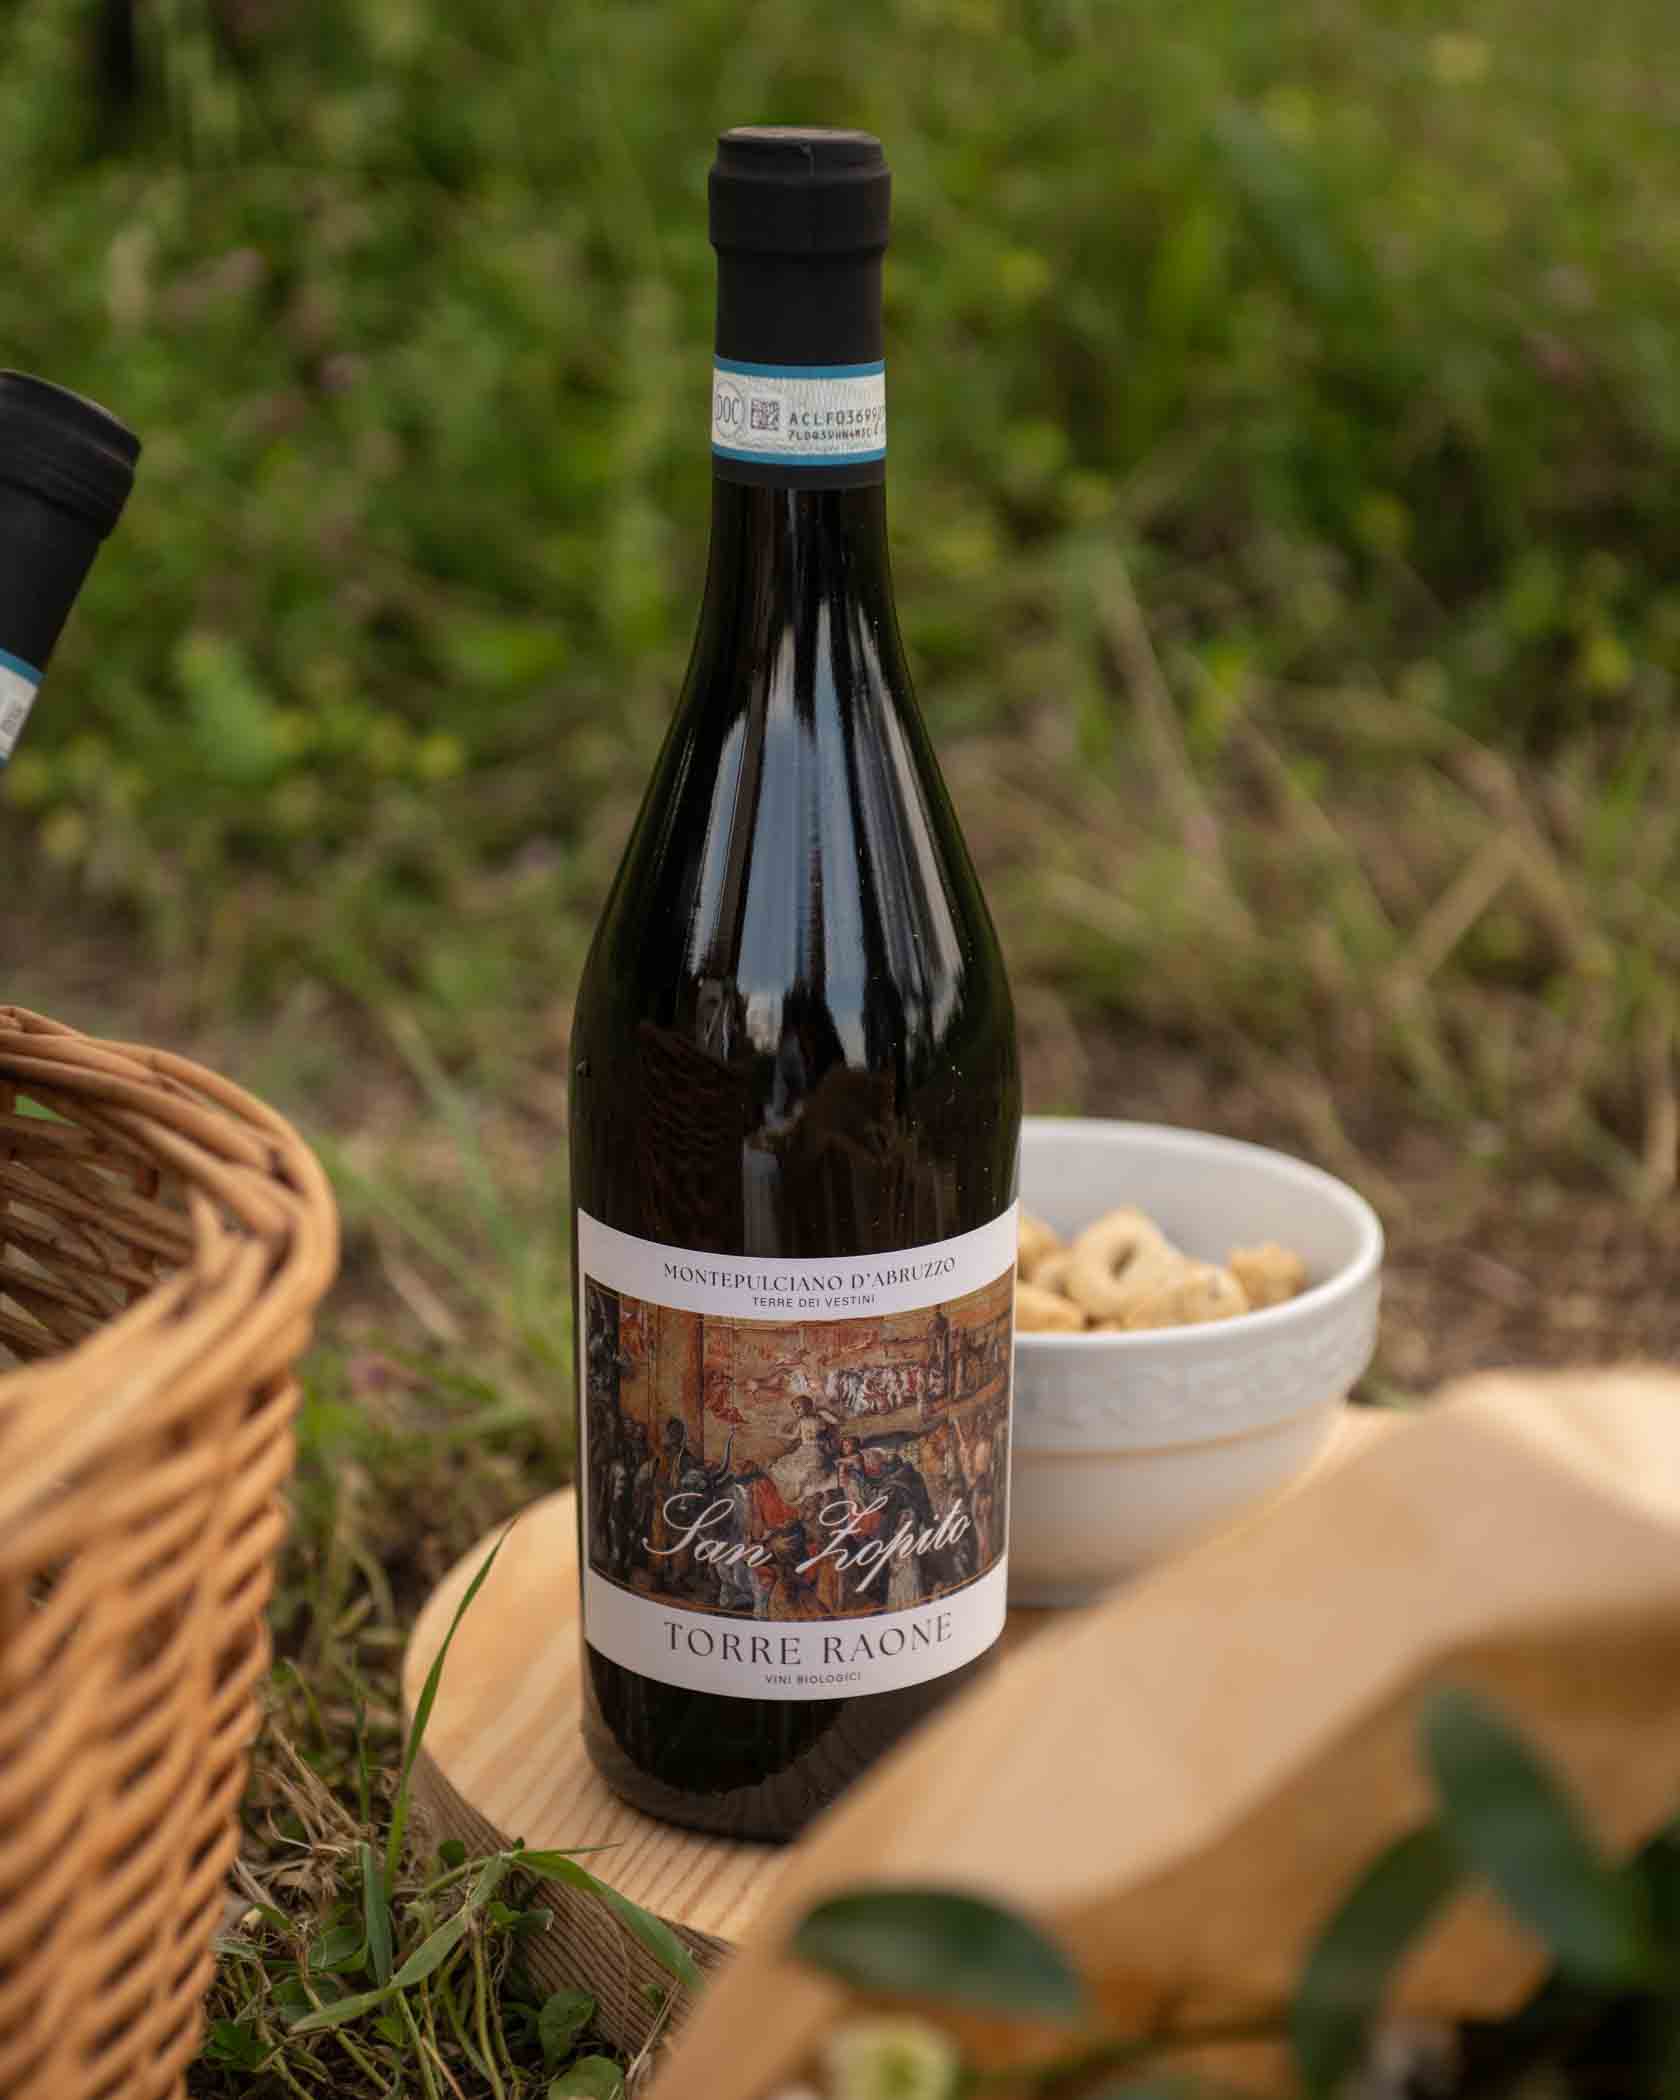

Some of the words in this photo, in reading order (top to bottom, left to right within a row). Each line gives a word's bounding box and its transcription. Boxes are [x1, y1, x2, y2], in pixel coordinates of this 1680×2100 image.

[663, 1262, 843, 1292] MONTEPULCIANO
[851, 1257, 956, 1291] D'ABRUZZO
[752, 1296, 794, 1309] TERRE
[798, 1297, 820, 1308] DEI
[825, 1295, 876, 1308] VESTINI
[641, 1492, 774, 1569] San
[795, 1495, 972, 1593] Zopito
[663, 1621, 801, 1665] TORRE
[823, 1612, 952, 1664] RAONE
[764, 1674, 793, 1686] VINI
[796, 1672, 861, 1685] BIOLOGICI
